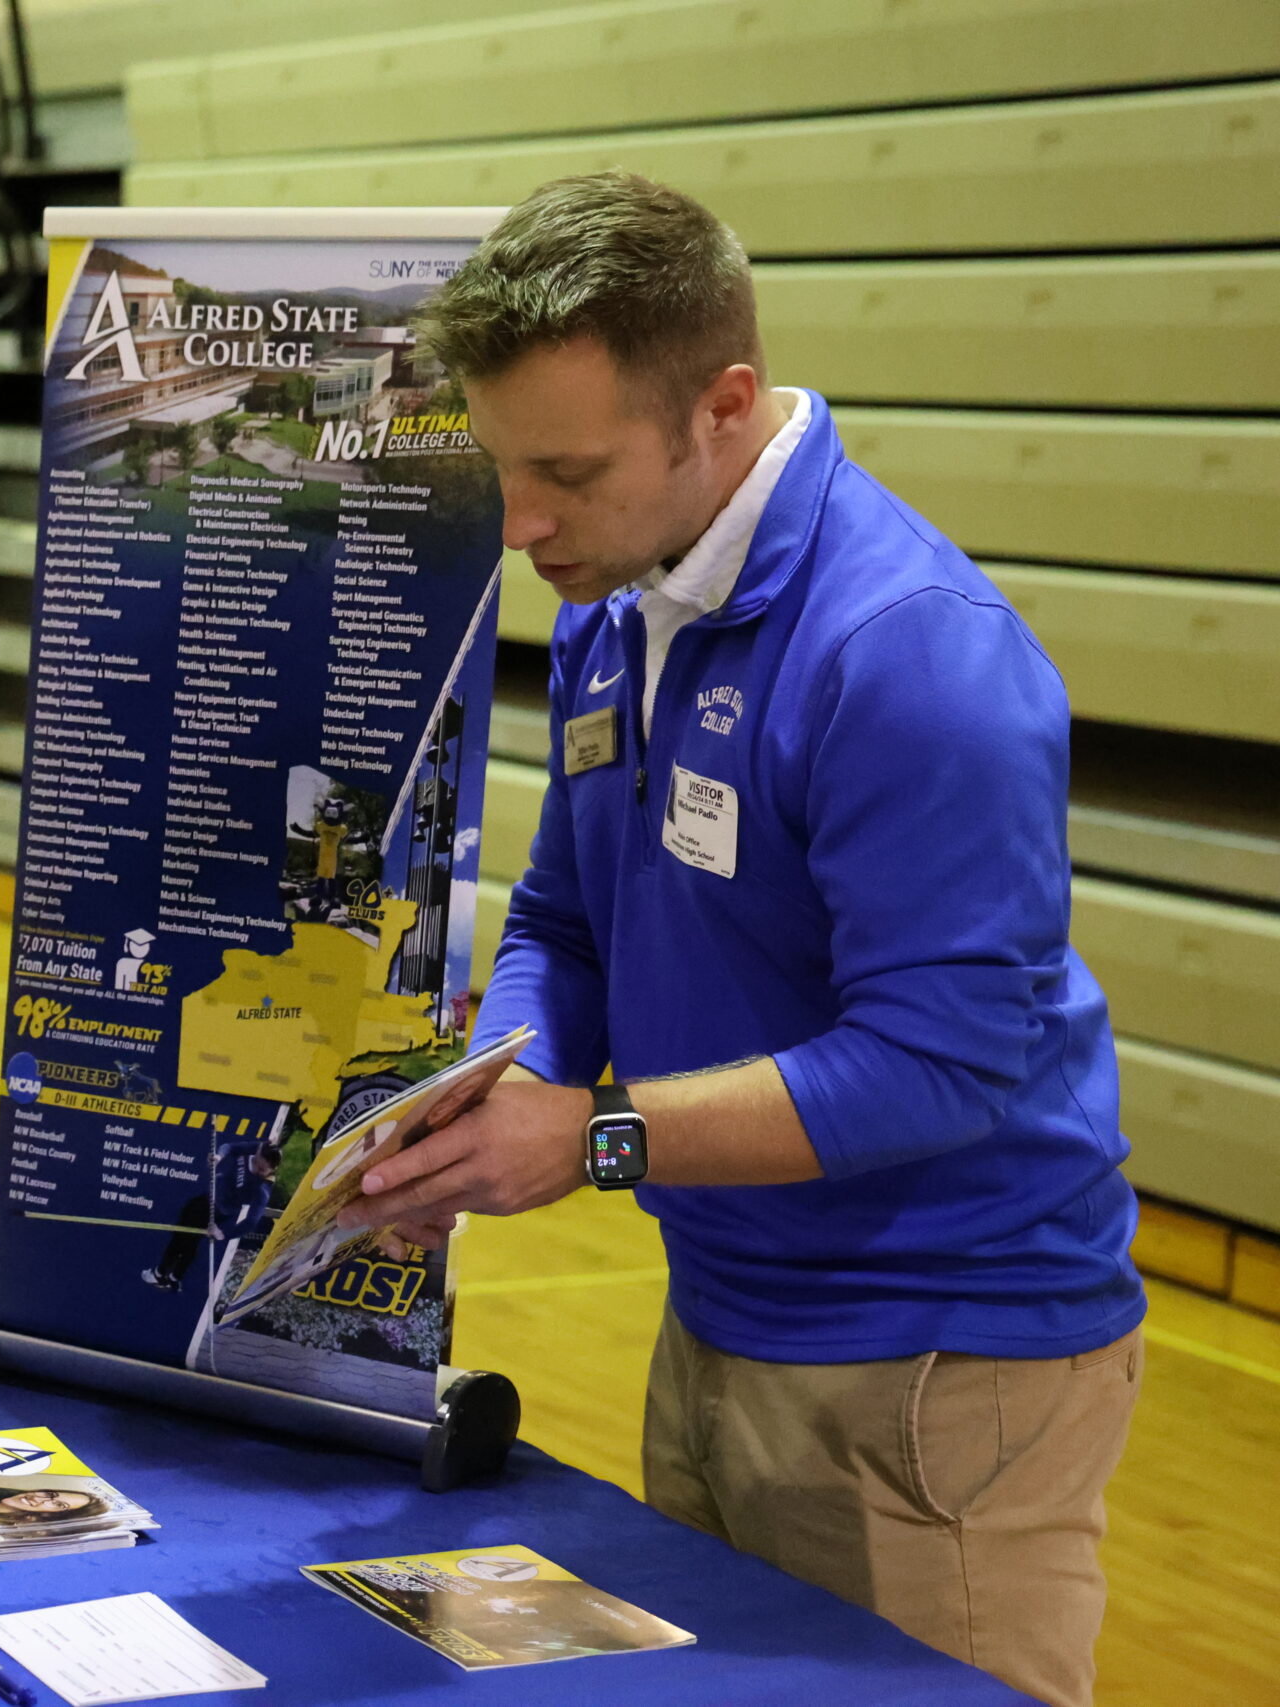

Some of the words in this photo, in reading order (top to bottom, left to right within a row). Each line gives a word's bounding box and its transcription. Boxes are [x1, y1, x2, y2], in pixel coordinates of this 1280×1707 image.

[369, 260, 415, 278] SUNY
[147, 297, 263, 332] ALFRED
[270, 299, 358, 333] STATE
[183, 333, 313, 368] COLLEGE
[391, 414, 469, 435] ULTIMA
[314, 418, 391, 462] No.1
[387, 433, 446, 450] COLLEGE
[450, 431, 473, 446] TO
[191, 476, 228, 487] Diagnostic
[230, 478, 258, 487] Medical
[260, 479, 304, 492] Sonography
[341, 483, 385, 494] Motorsports
[388, 485, 431, 497] Technology
[340, 499, 369, 509] Network
[372, 500, 428, 512] Administration
[338, 515, 367, 526] Nursing
[186, 535, 219, 545] Electrical
[221, 537, 264, 550] Engineering
[266, 540, 308, 552] Technology
[337, 531, 406, 543] Pre-Environmental
[345, 544, 372, 554] Science
[382, 546, 414, 558] Forestry
[335, 560, 372, 572] Radiologic
[375, 562, 418, 574] Technology
[334, 576, 356, 585] Social
[358, 577, 387, 587] Science
[333, 592, 352, 603] Sport
[354, 593, 402, 605] Management
[331, 608, 367, 621] Surveying
[369, 610, 382, 619] and
[384, 611, 424, 622] Geomatics
[179, 629, 202, 639] Health
[204, 631, 236, 642] Sciences
[339, 620, 381, 634] Engineering
[384, 624, 427, 637] Technology
[329, 636, 364, 649] Surveying
[366, 639, 411, 653] Engineering
[337, 648, 378, 661] Technology
[327, 664, 361, 675] Technical
[363, 667, 422, 679] Communication
[341, 678, 375, 690] Emergent
[377, 680, 400, 690] Media
[175, 692, 196, 704] Heavy
[198, 694, 235, 706] Equipment
[237, 697, 277, 708] Operations
[325, 692, 365, 706] Technology
[367, 696, 416, 708] Management
[697, 686, 734, 711] ALFRED
[324, 709, 364, 720] Undeclared
[322, 724, 358, 738] Veterinary
[361, 728, 404, 741] Technology
[321, 741, 336, 750] Web
[338, 742, 385, 755] Development
[170, 750, 195, 760] Human
[197, 752, 228, 763] Services
[230, 755, 277, 768] Management
[320, 756, 348, 769] Welding
[350, 759, 392, 774] Technology
[689, 779, 724, 802] VISITOR
[163, 860, 199, 874] Marketing
[159, 907, 200, 919] Mechanical
[201, 911, 244, 926] Engineering
[246, 916, 287, 931] Technology
[348, 907, 386, 920] CLUBS
[56, 940, 97, 960] Tuition
[16, 955, 43, 973] From
[45, 959, 68, 980] Any
[70, 963, 103, 982] State
[140, 962, 173, 984] 93%
[129, 982, 149, 993] GET
[150, 984, 169, 995] AID
[13, 994, 72, 1039] 98%
[236, 1007, 271, 1020] ALFRED
[273, 1007, 302, 1019] STATE
[68, 1018, 163, 1042] EMPLOYMENT
[52, 1031, 93, 1045] CONTINUING
[94, 1037, 134, 1051] EDUCATION
[136, 1043, 155, 1054] RATE
[38, 1060, 119, 1088] PIONEERS
[8, 1077, 42, 1095] NCAA
[54, 1091, 77, 1106] D-III
[81, 1096, 142, 1117] ATHLETICS
[332, 1102, 358, 1131] FRED
[363, 1092, 395, 1106] STA
[15, 1110, 42, 1122] Baseball
[14, 1125, 27, 1135] M/W
[105, 1125, 134, 1137] Softball
[12, 1141, 26, 1152] M/W
[28, 1144, 46, 1155] Cross
[48, 1147, 76, 1161] Country
[104, 1141, 120, 1151] M/W
[123, 1144, 142, 1155] Track
[151, 1148, 168, 1159] Field
[170, 1151, 195, 1163] Indoor
[11, 1157, 38, 1170] Football
[103, 1157, 119, 1168] M/W
[121, 1160, 140, 1171] Track
[149, 1165, 167, 1176] Field
[169, 1168, 198, 1181] Outdoor
[102, 1174, 137, 1187] Volleyball
[100, 1190, 117, 1200] M/W
[119, 1193, 153, 1208] Wrestling
[292, 1258, 426, 1316] ROS!
